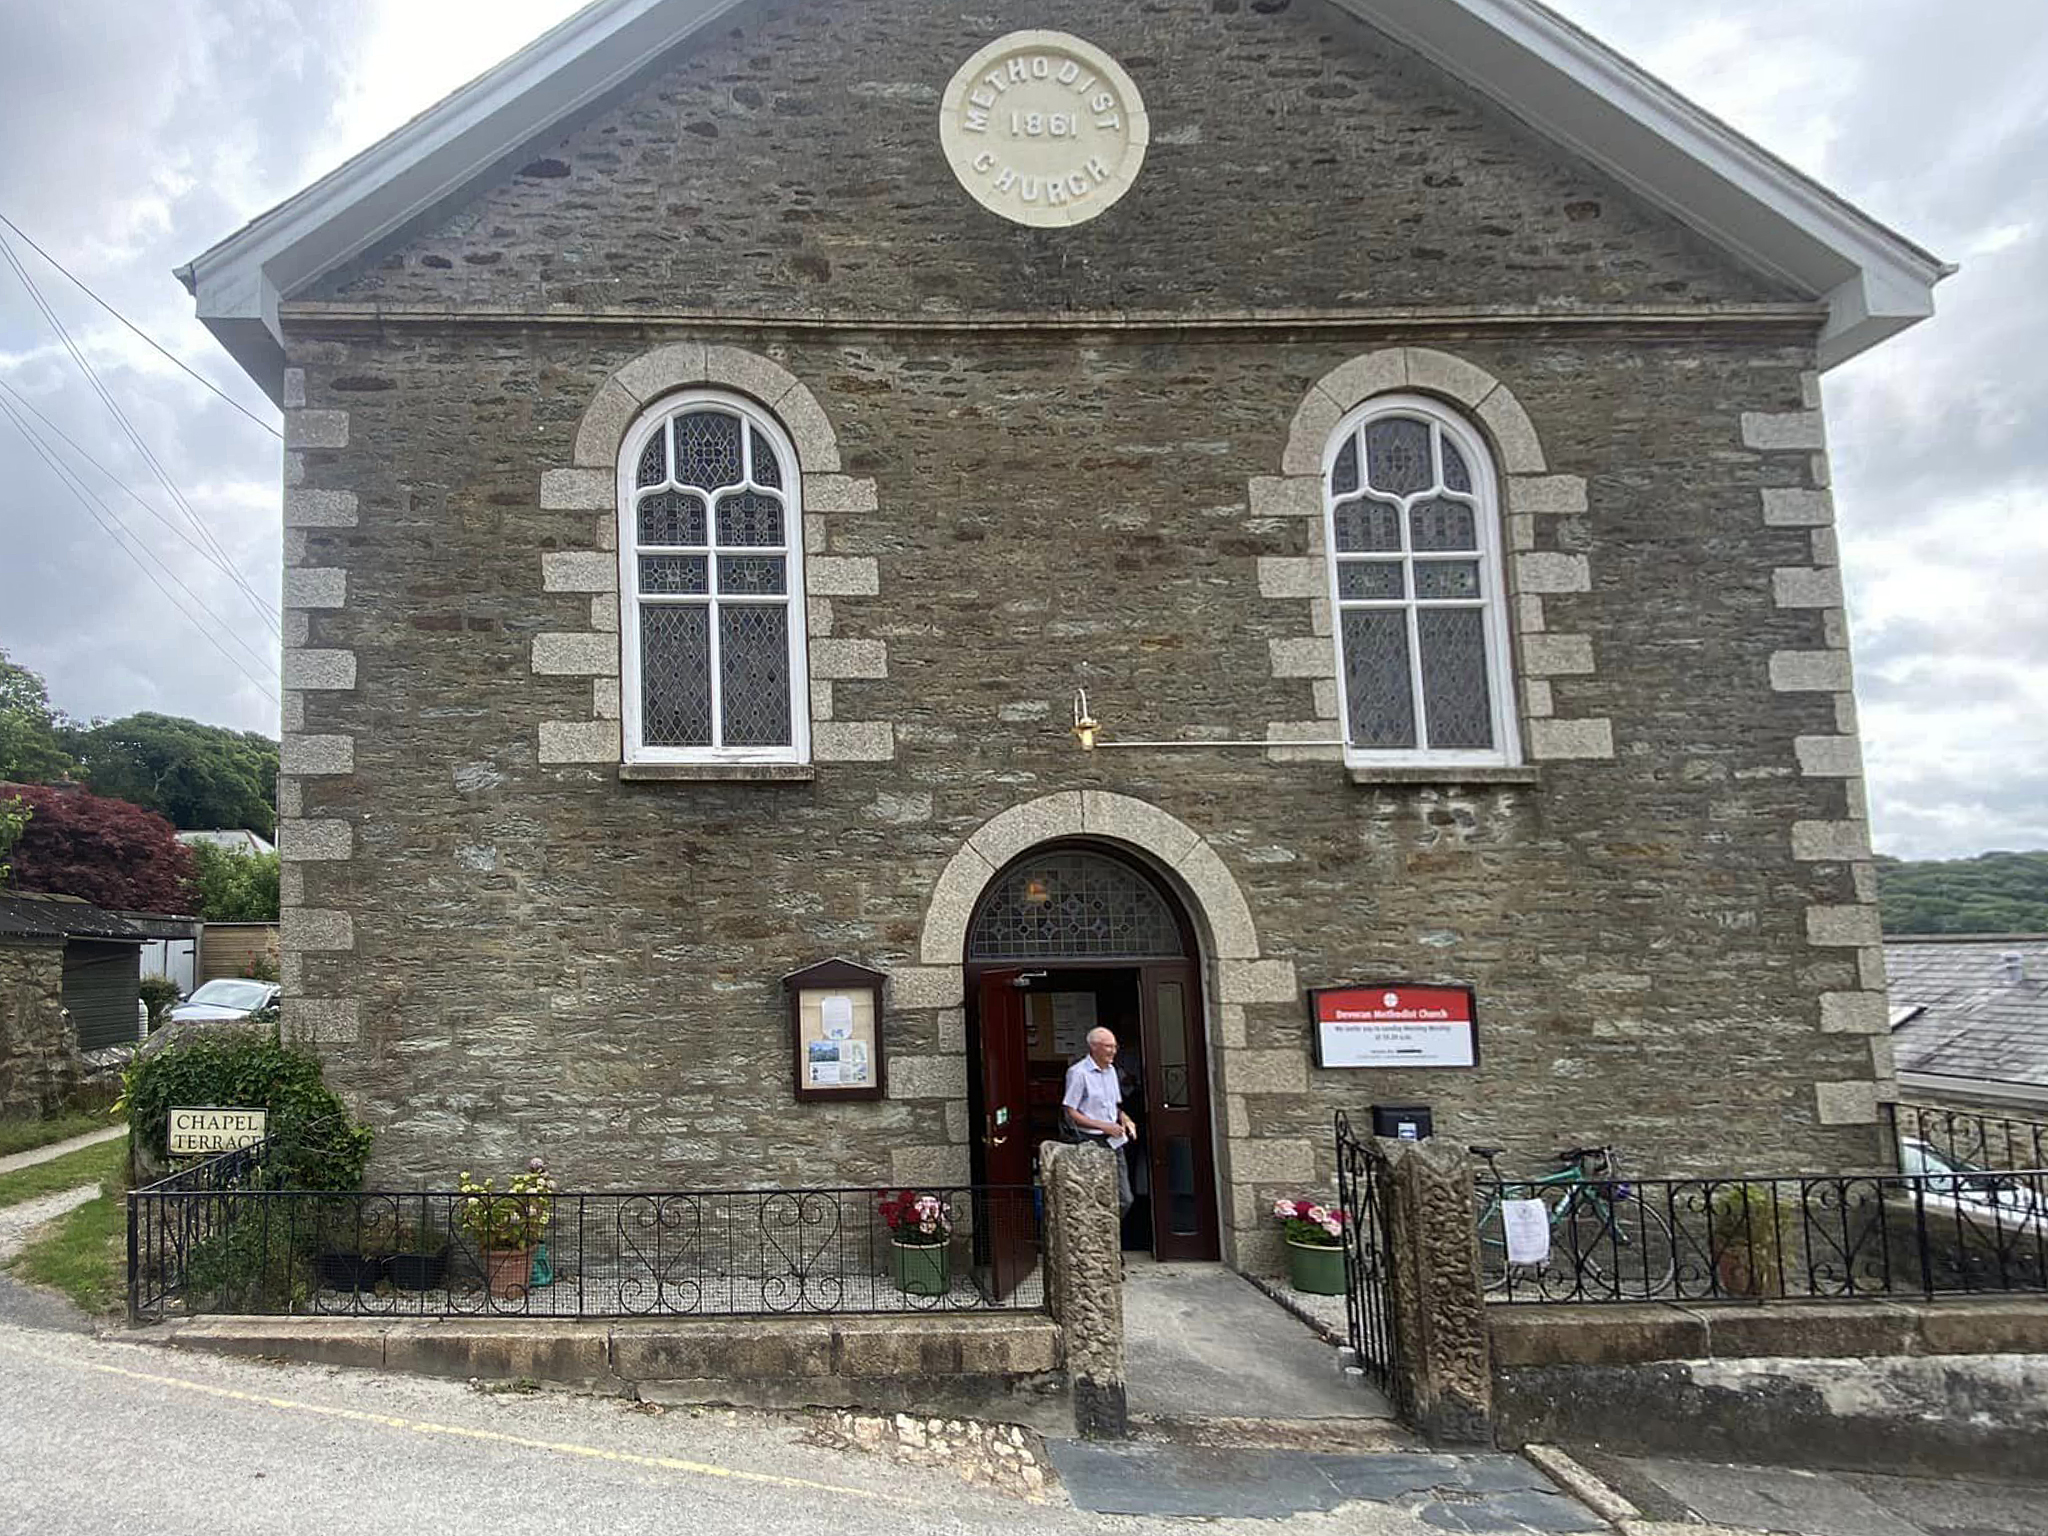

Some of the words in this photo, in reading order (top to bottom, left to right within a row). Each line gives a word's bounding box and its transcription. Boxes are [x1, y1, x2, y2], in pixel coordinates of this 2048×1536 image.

[963, 56, 1120, 133] METHODIST
[1011, 112, 1077, 139] 1861
[972, 153, 1110, 205] CHURCH
[1373, 1009, 1416, 1019] Methodist
[1419, 1009, 1449, 1019] Church
[177, 1115, 258, 1130] CHAPEL
